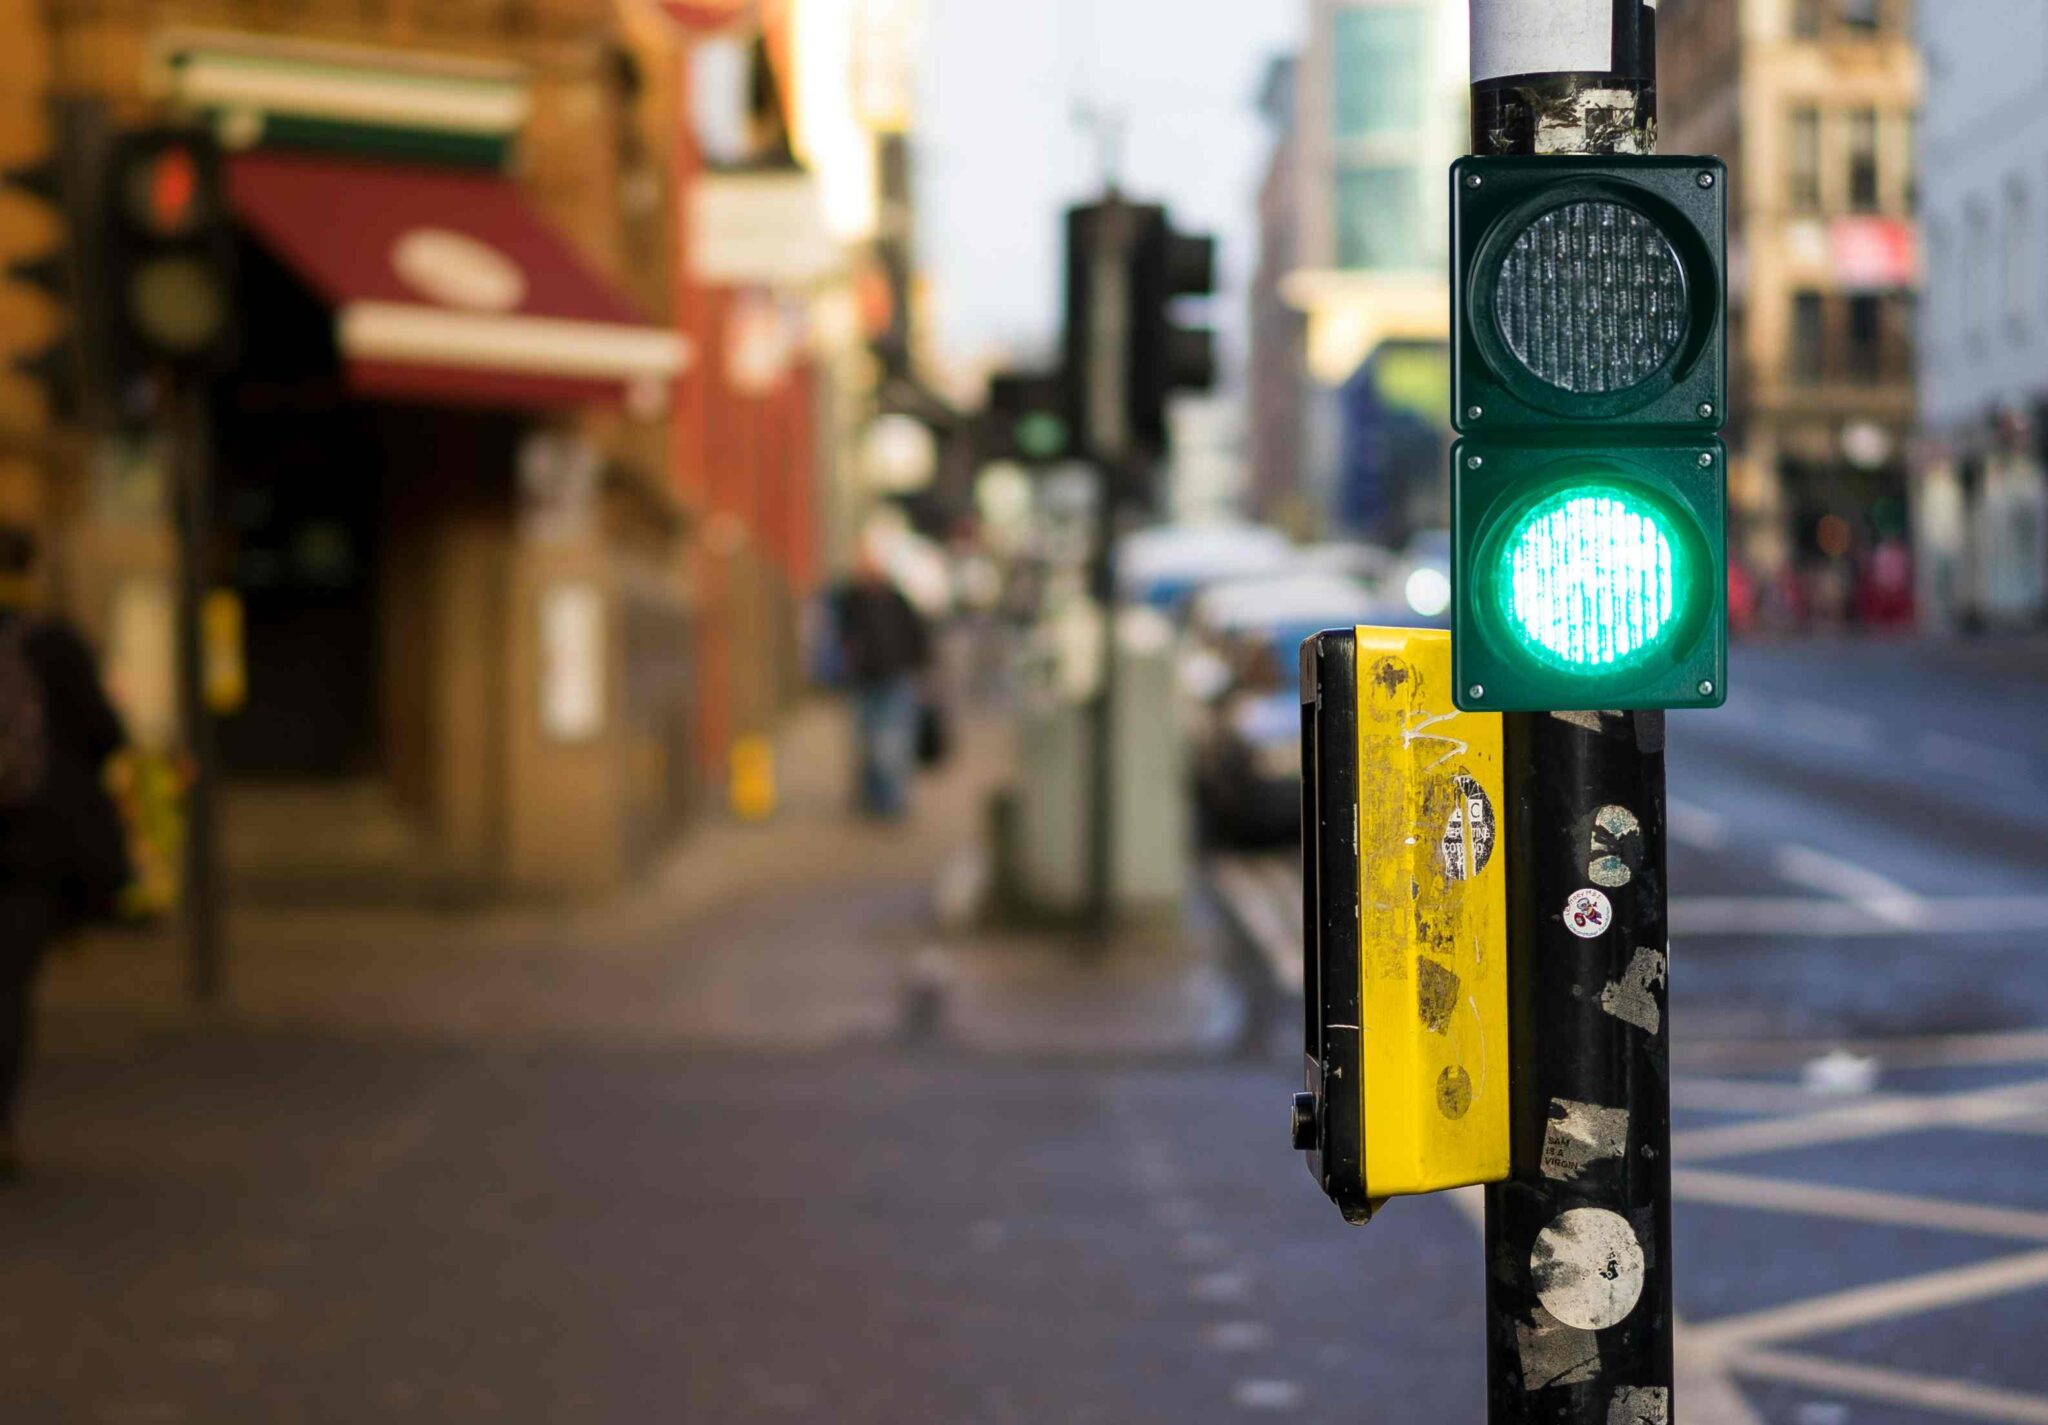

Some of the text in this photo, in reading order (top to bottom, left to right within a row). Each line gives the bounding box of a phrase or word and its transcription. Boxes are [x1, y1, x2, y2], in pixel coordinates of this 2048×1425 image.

[1548, 1136, 1569, 1146] SAM
[1545, 1146, 1564, 1157] IS A
[1545, 1157, 1578, 1169] VIRGIN
